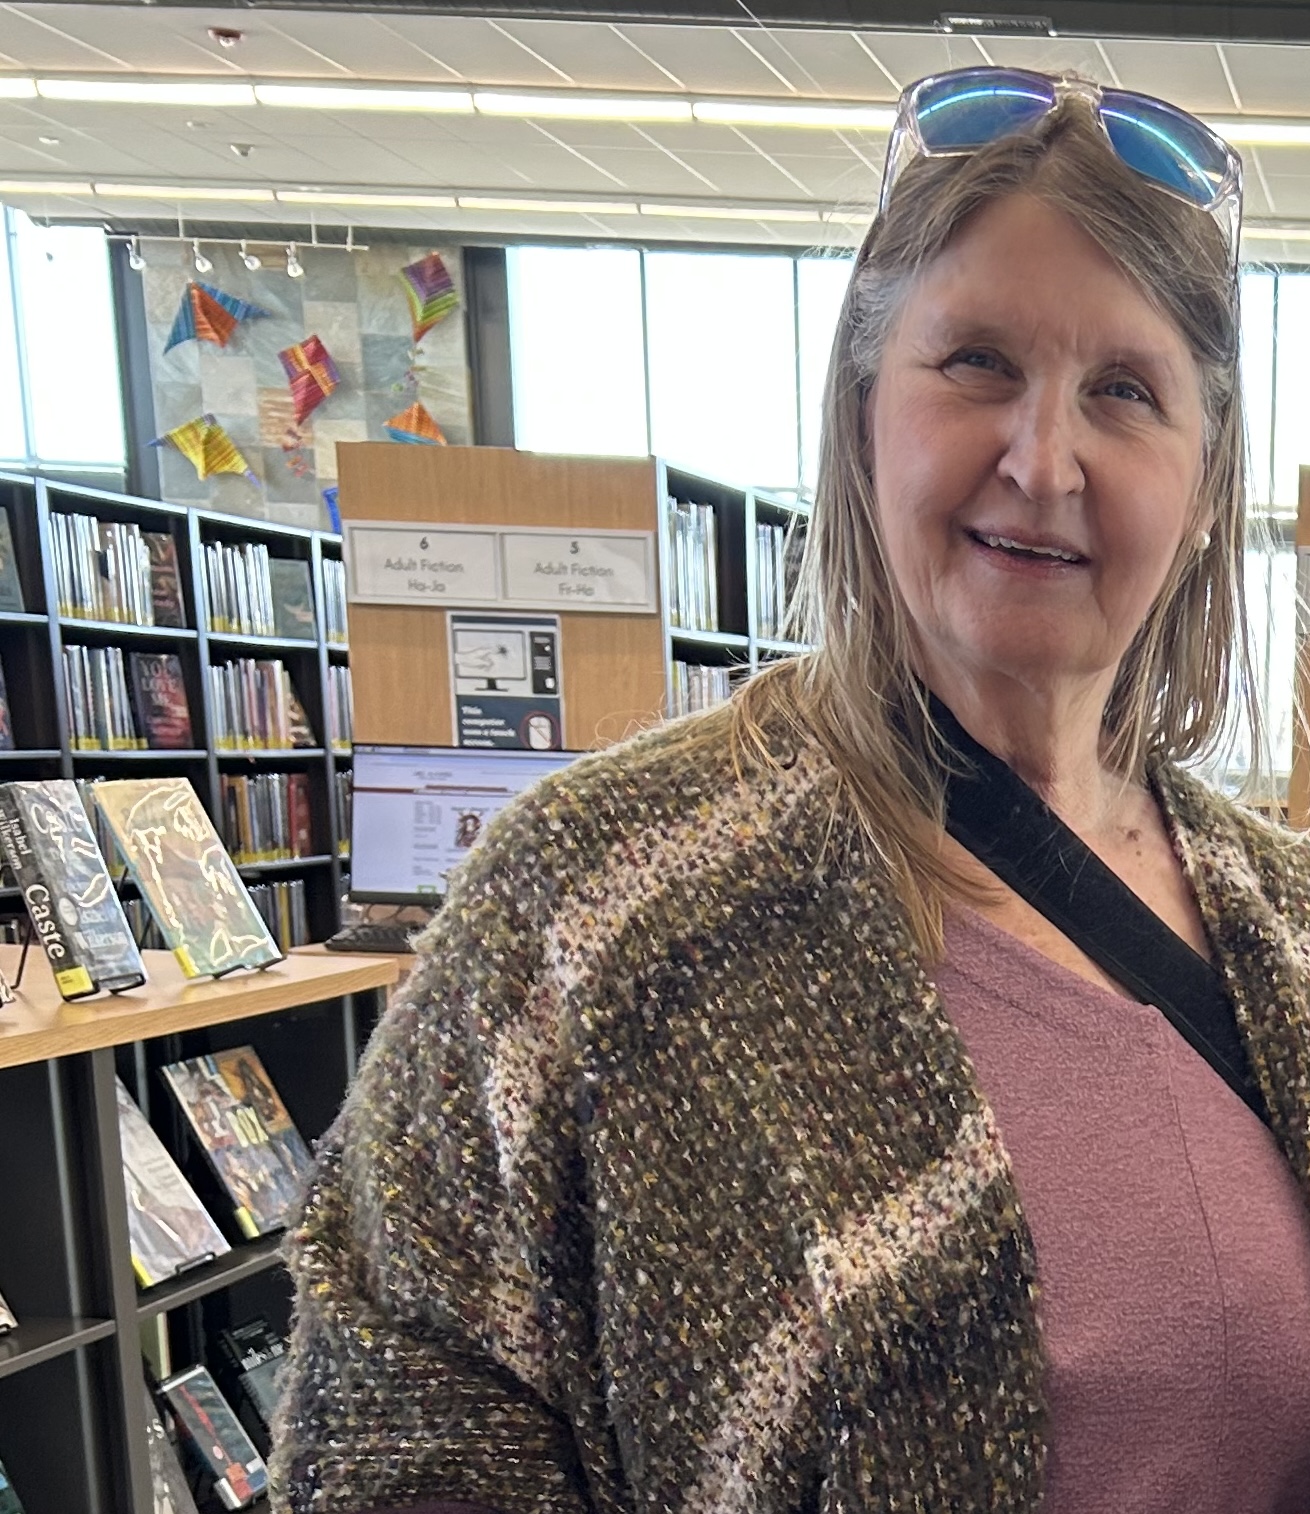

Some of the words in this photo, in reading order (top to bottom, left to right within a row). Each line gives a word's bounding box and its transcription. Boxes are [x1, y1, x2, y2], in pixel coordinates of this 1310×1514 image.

[420, 537, 429, 550] 6
[570, 541, 579, 554] 5
[384, 557, 417, 571] Adult
[420, 558, 464, 572] Fiction
[534, 562, 568, 575] Adult
[571, 563, 614, 577] Fiction
[26, 884, 66, 960] Caste
